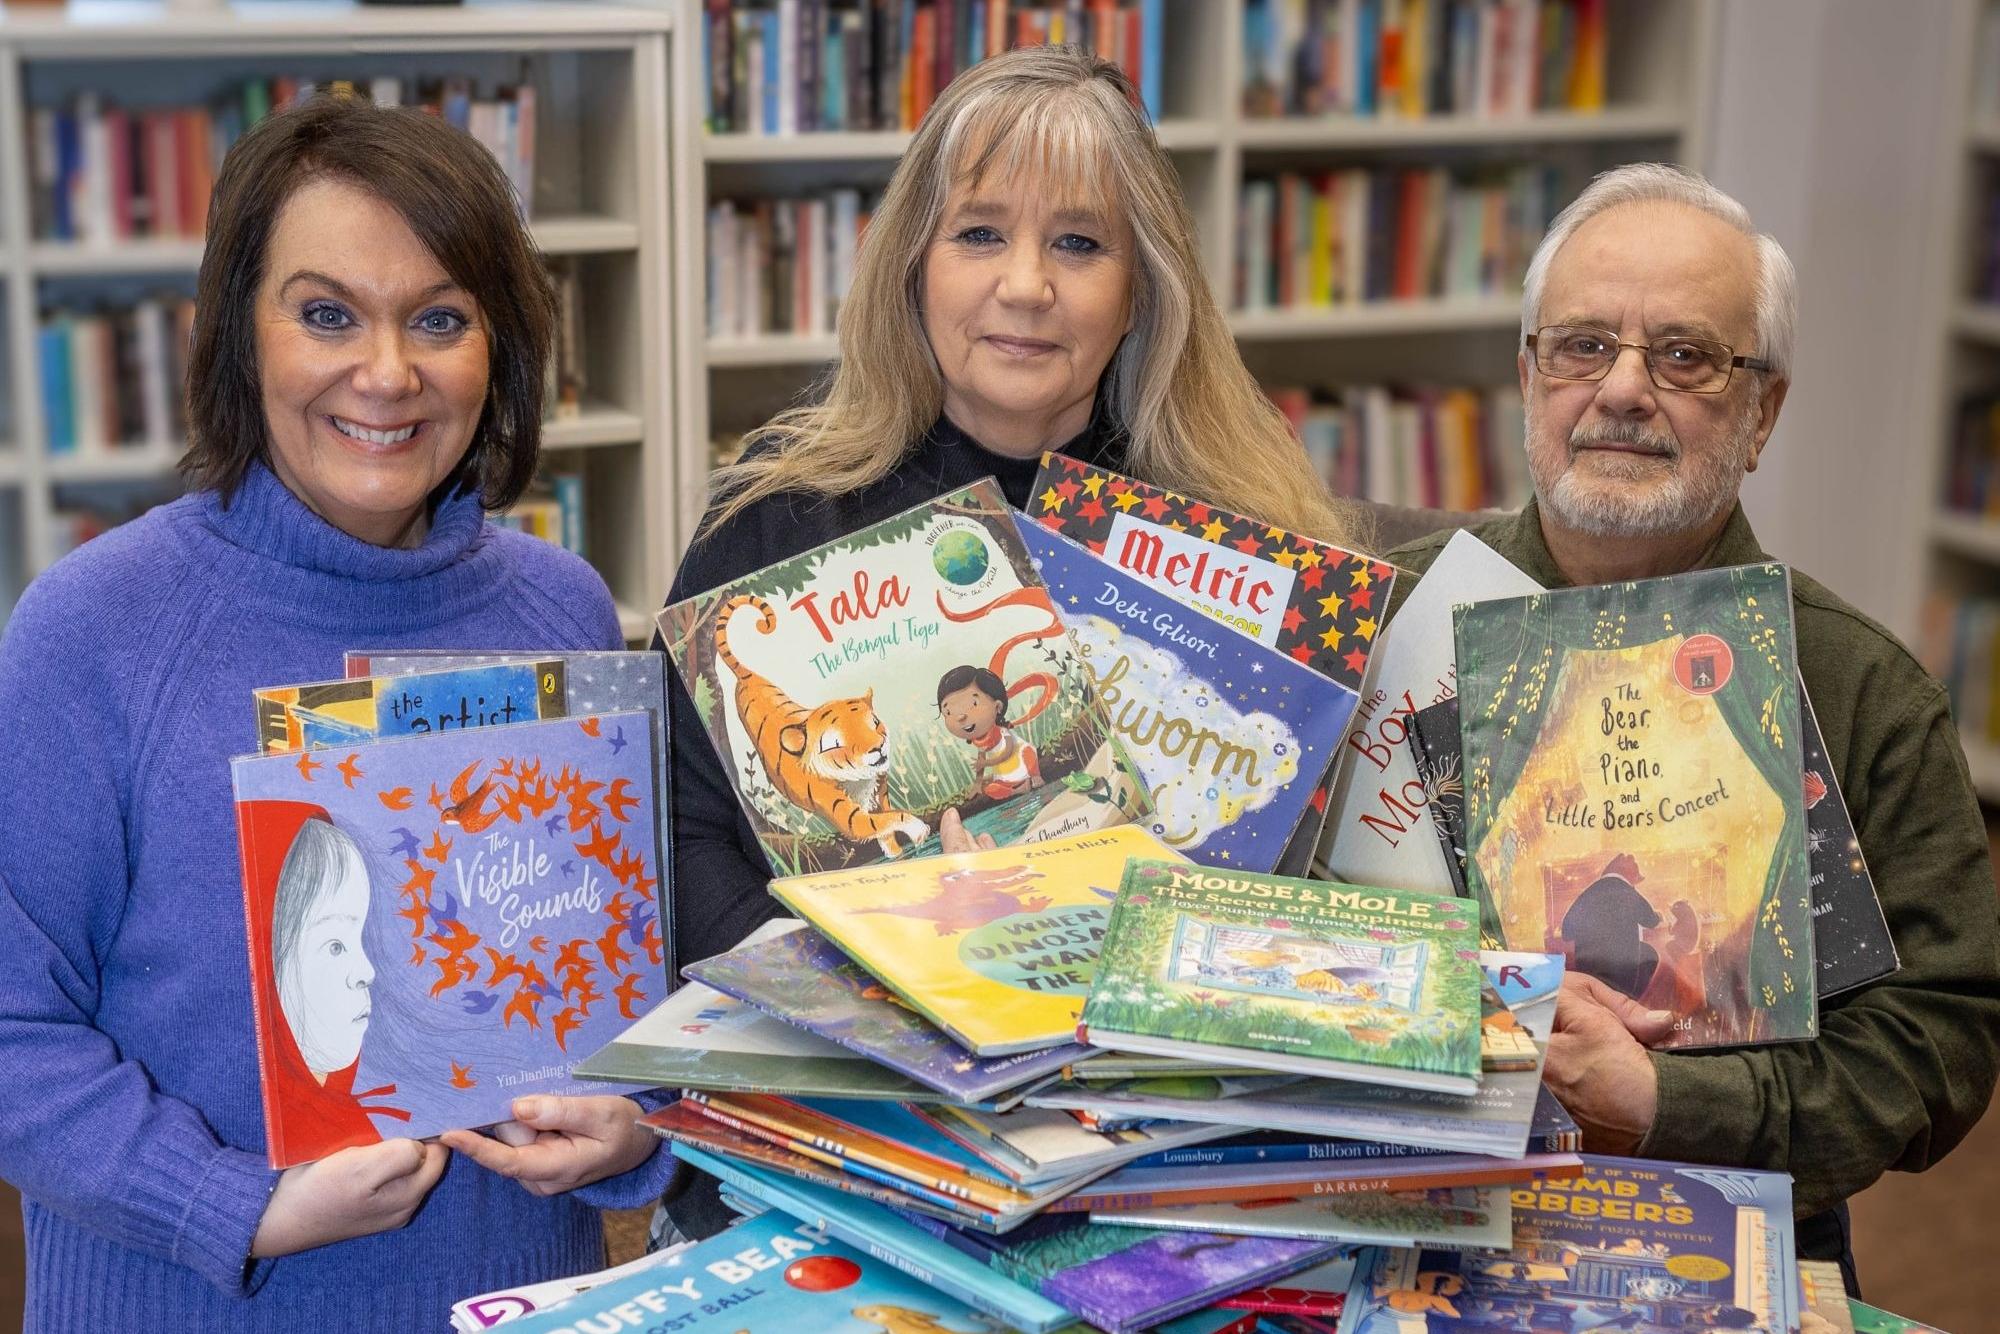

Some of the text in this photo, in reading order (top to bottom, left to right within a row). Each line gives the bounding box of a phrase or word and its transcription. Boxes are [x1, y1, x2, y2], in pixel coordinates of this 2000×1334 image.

[1118, 528, 1274, 615] Melric
[790, 570, 911, 643] Tala
[1094, 582, 1219, 659] Debi Gliori
[809, 616, 941, 679] The Bengal Tiger
[391, 692, 422, 719] the
[1432, 679, 1455, 705] nd
[1615, 683, 1641, 700] The
[1617, 735, 1639, 751] the
[1546, 778, 1729, 830] Little Bear's Concert
[1620, 787, 1640, 804] and
[484, 832, 509, 855] The
[1076, 837, 1119, 850] Hicks
[456, 839, 552, 907] Visible
[500, 865, 604, 948] Sounds
[1152, 886, 1445, 931] The Secret of Happiness
[1170, 872, 1433, 917] MOUSE & MOLE
[1002, 909, 1105, 935] WHEN
[1170, 899, 1424, 937] Joyce Dunbar and James Mayhew
[969, 926, 1106, 960] DINOSA
[1015, 970, 1091, 991] THE
[496, 1074, 516, 1087] Yin
[518, 1066, 564, 1084] Jianling
[1164, 1149, 1224, 1163] Lounsbury
[1309, 1143, 1362, 1159] Balloon
[1366, 1145, 1381, 1157] to
[1385, 1143, 1407, 1156] the
[1314, 1180, 1389, 1194] BARROUX
[1511, 1190, 1694, 1225] OBBERS
[647, 1286, 765, 1334] OST BALL
